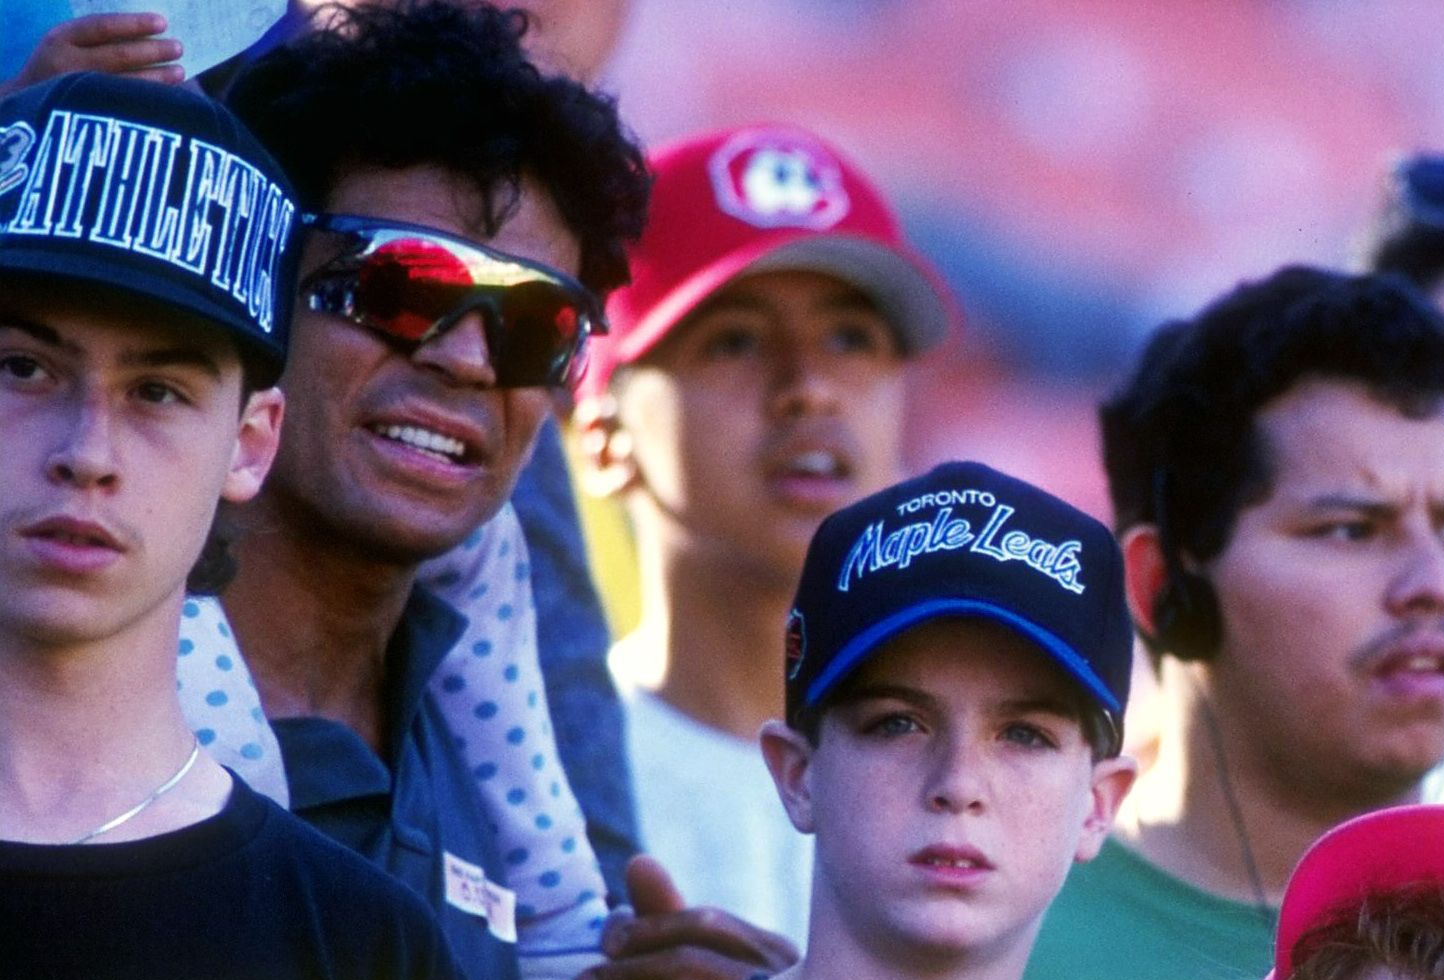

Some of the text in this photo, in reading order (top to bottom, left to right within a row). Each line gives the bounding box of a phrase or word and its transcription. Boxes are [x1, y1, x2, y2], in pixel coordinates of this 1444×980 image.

[7, 109, 295, 324] ATHLETICS
[897, 489, 996, 516] TORONTO
[838, 504, 1086, 595] Maple Leafs
